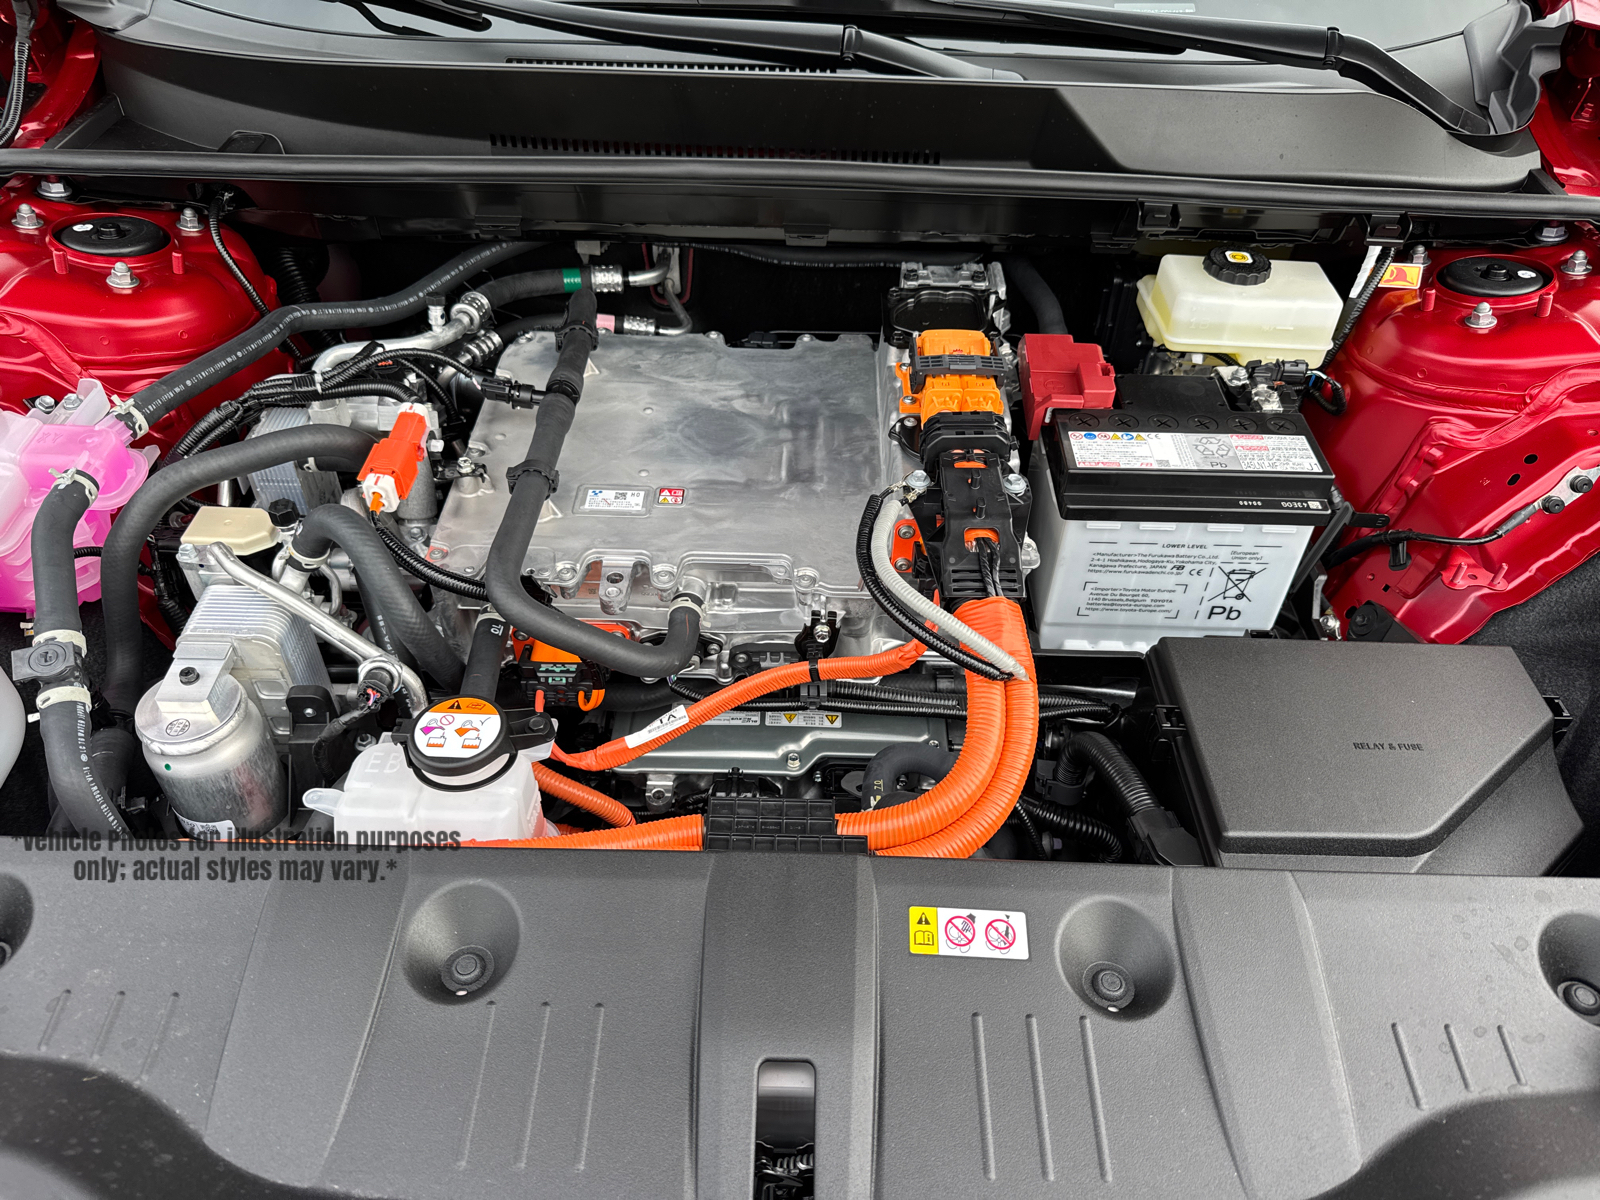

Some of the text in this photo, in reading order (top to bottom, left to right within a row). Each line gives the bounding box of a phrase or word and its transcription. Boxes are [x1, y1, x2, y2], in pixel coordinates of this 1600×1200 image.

[1210, 461, 1228, 469] Pb
[1207, 605, 1242, 621] Pb
[1353, 742, 1385, 750] RELAY
[1397, 743, 1425, 751] FUSE
